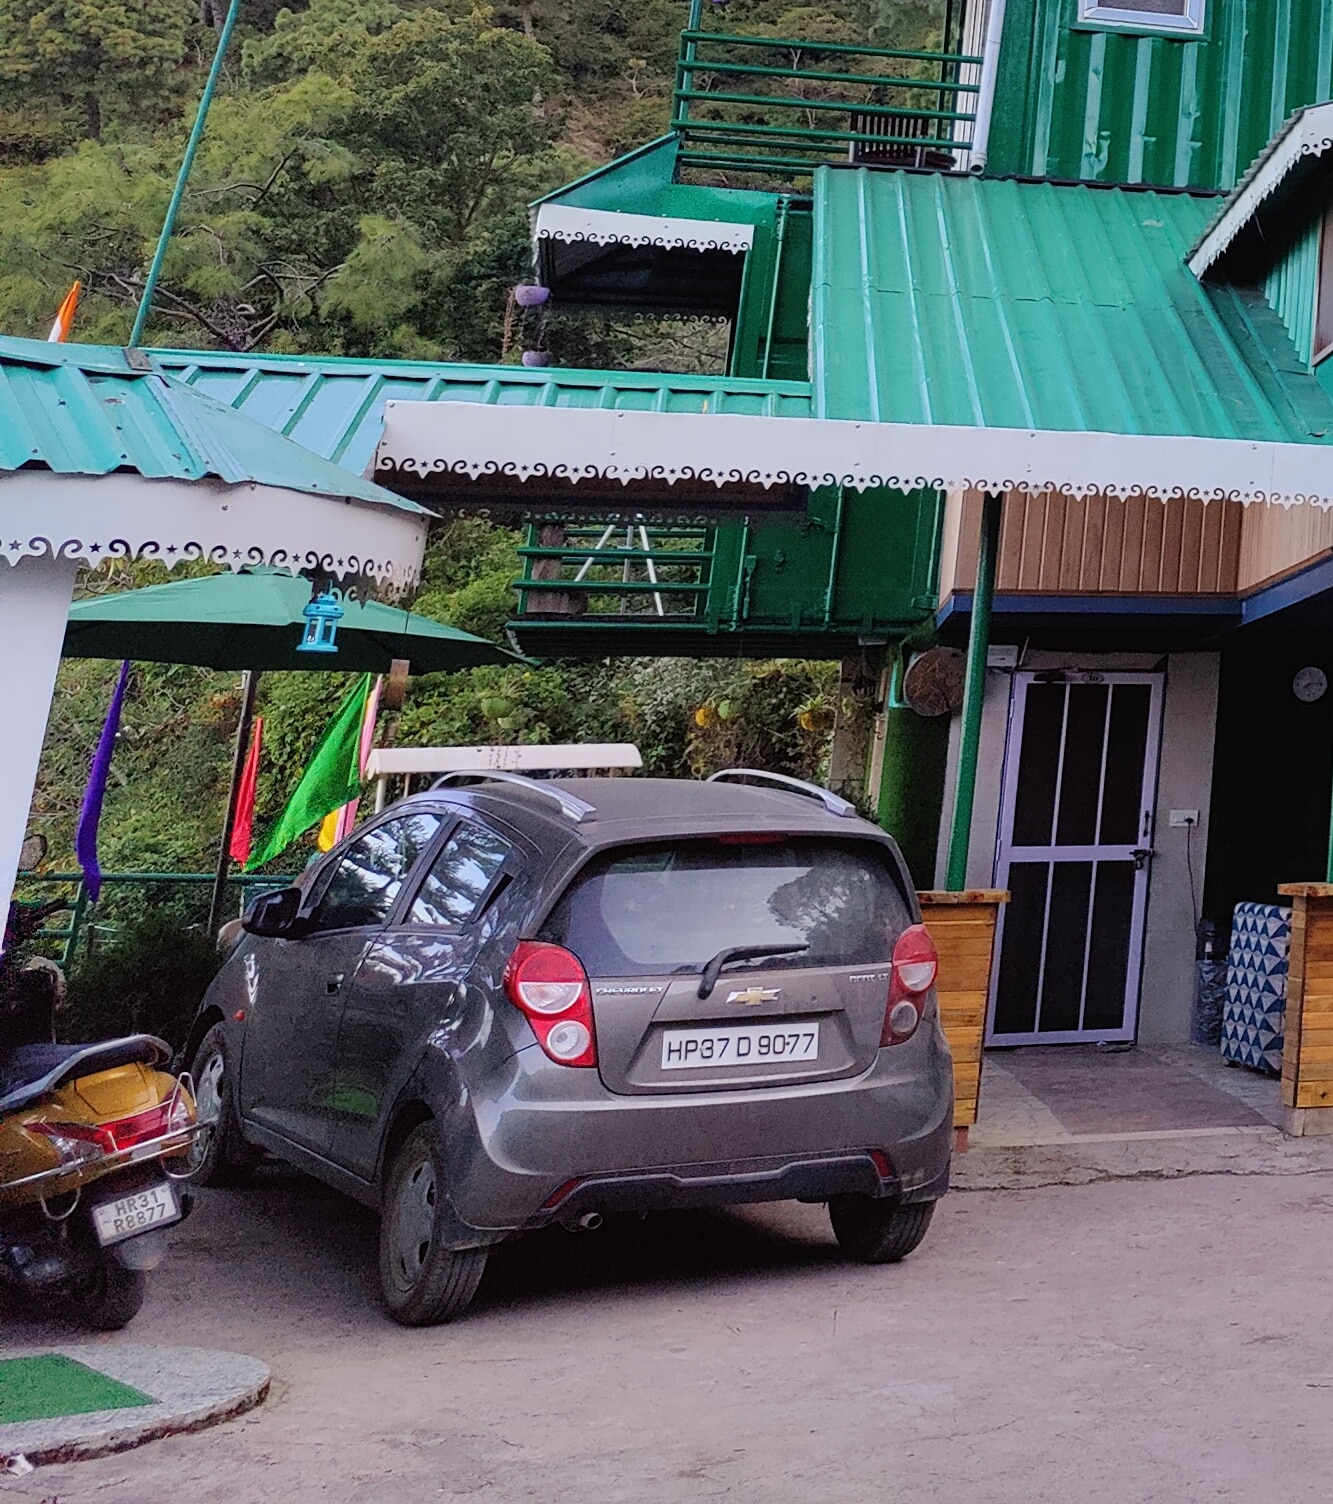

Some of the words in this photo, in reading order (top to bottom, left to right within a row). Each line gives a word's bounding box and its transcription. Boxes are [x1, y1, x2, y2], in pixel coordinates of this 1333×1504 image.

[596, 985, 664, 995] CHEVROLET
[667, 1037, 730, 1062] HP37
[736, 1036, 752, 1058] D
[757, 1032, 816, 1056] 9077
[114, 1189, 159, 1216] HR31
[113, 1202, 167, 1234] R8877
